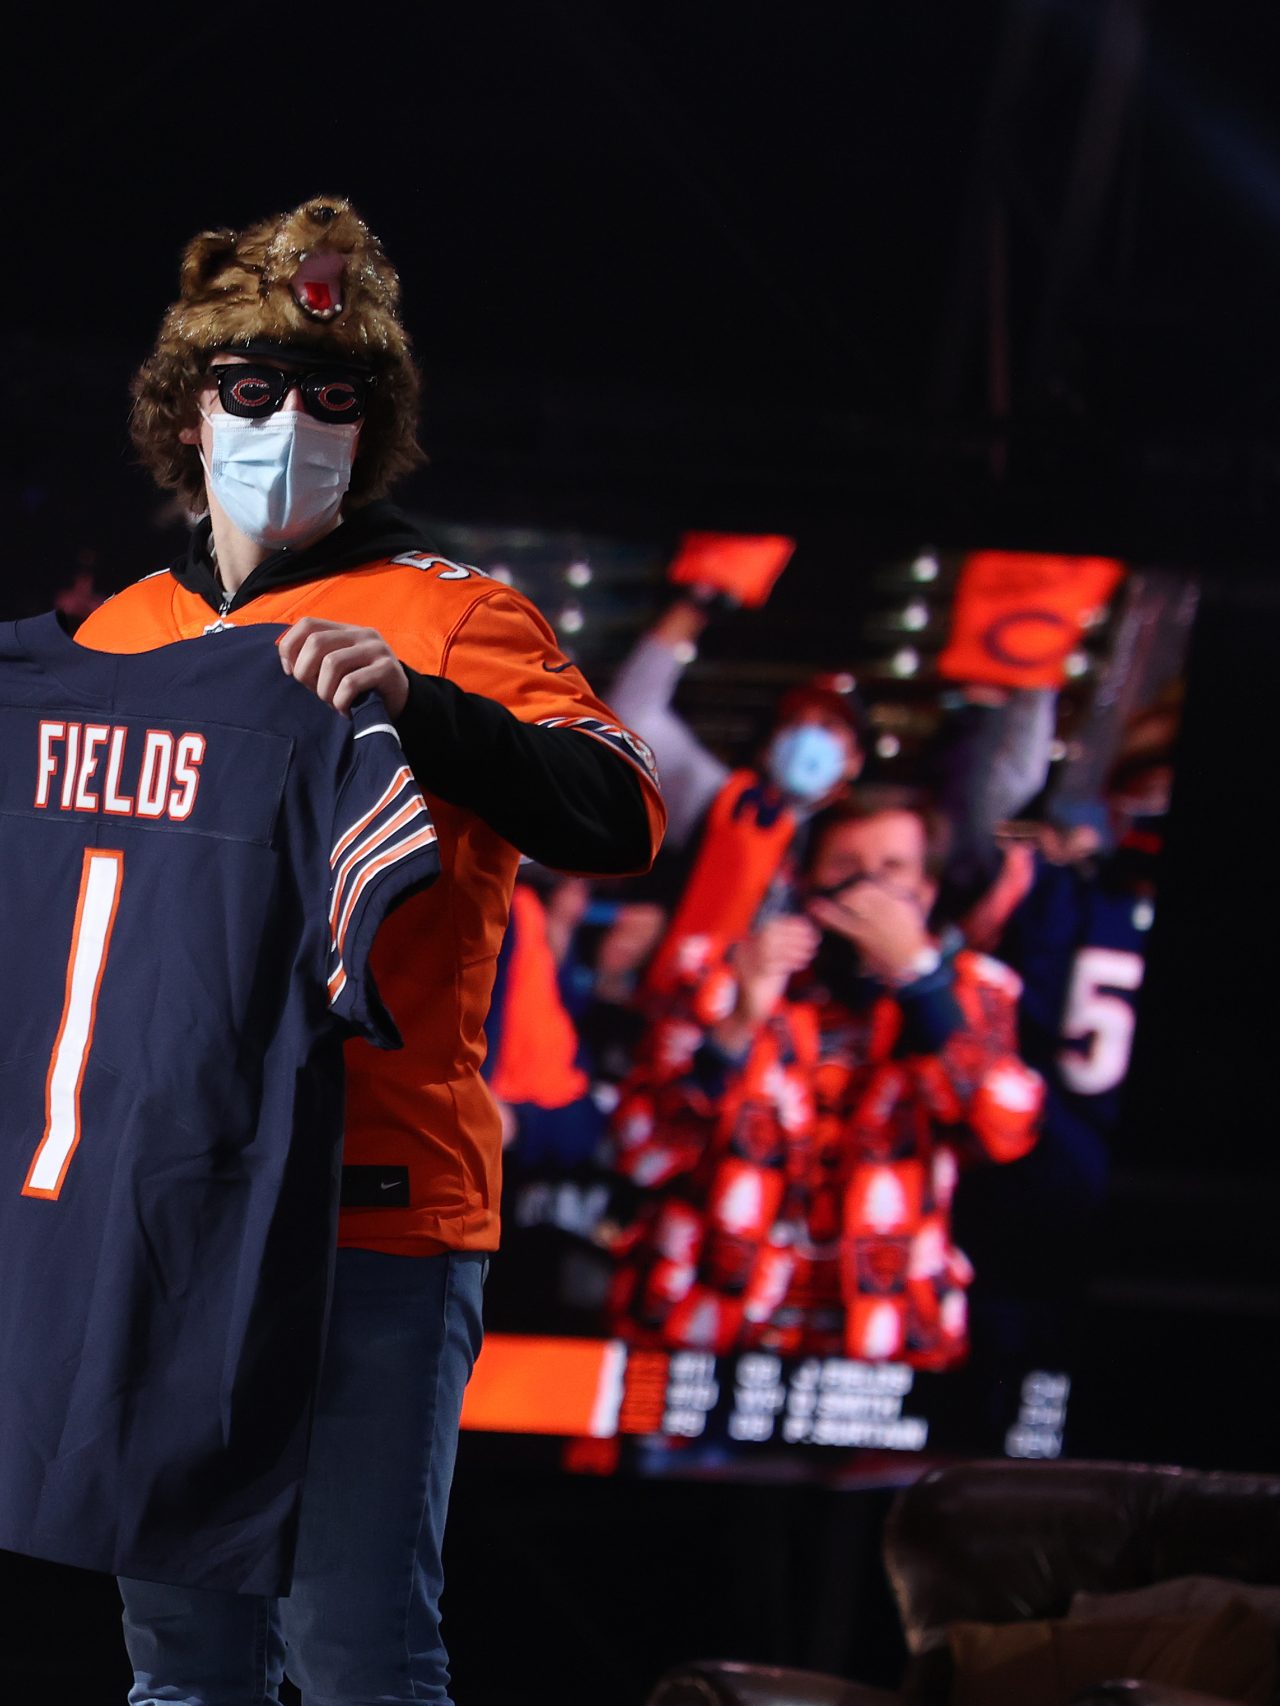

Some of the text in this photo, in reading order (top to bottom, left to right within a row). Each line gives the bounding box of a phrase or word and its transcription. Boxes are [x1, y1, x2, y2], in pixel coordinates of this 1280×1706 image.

[34, 719, 207, 822] FIELDS
[20, 846, 125, 1202] 1
[1060, 946, 1145, 1095] 5
